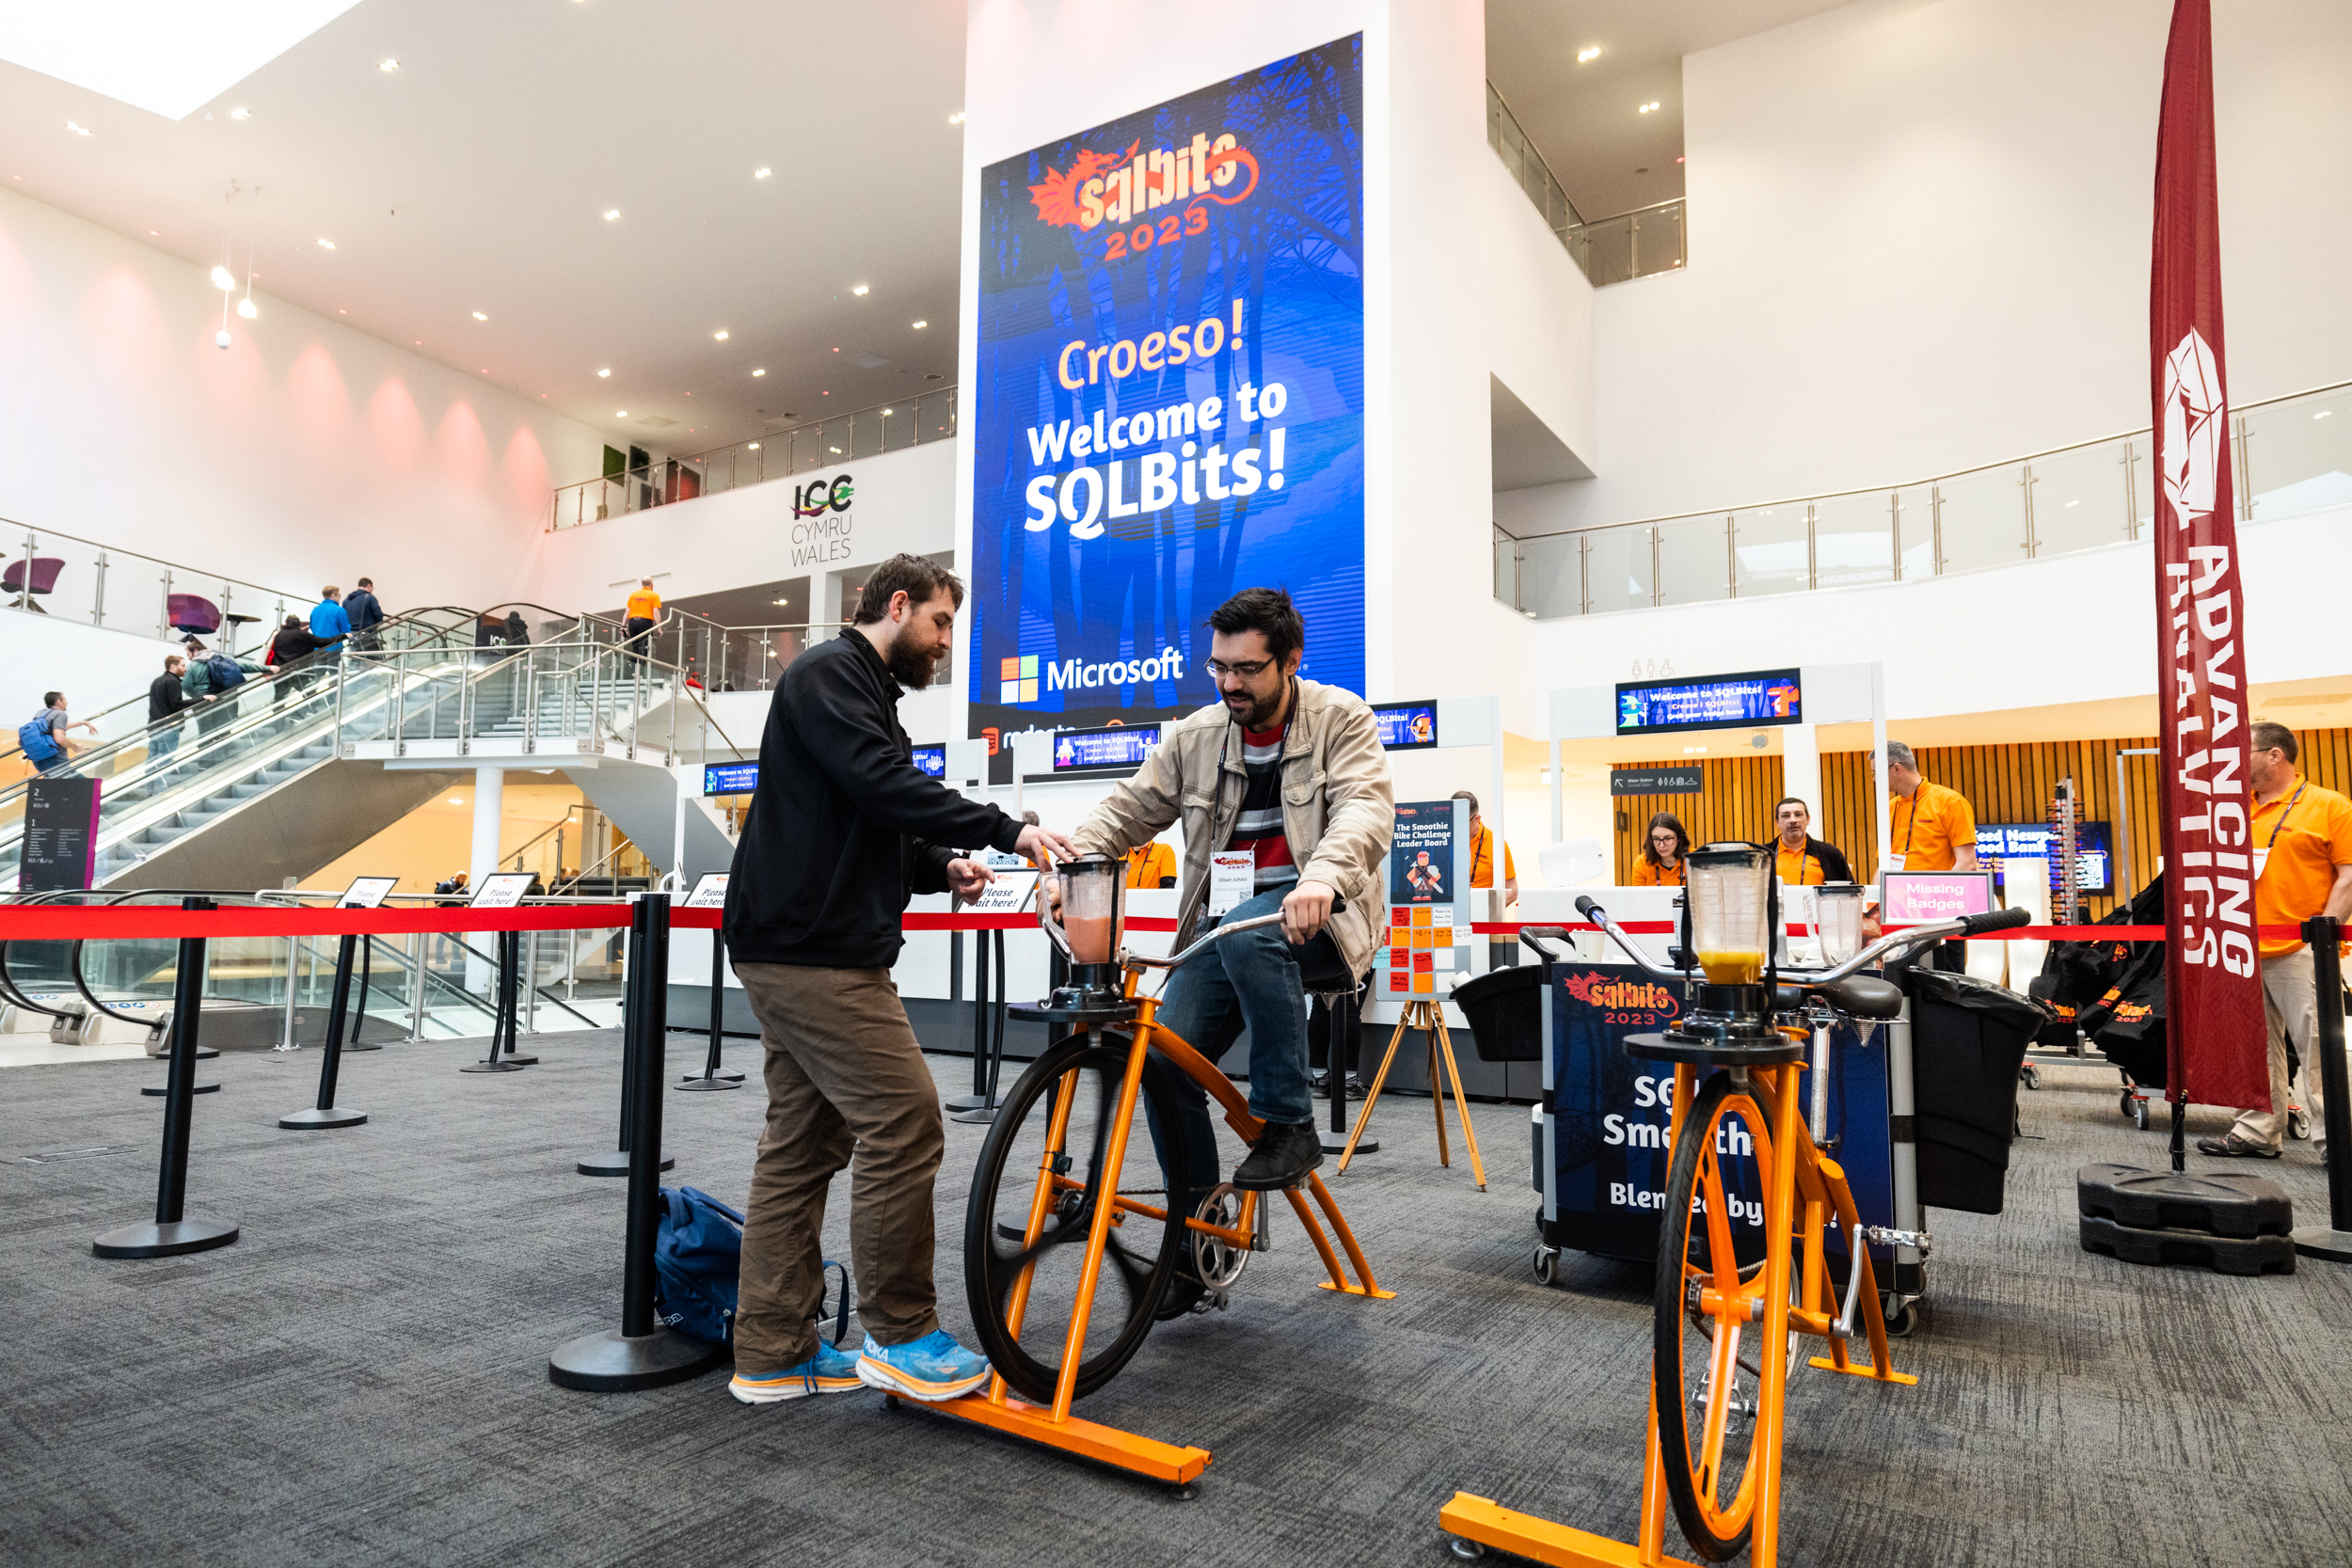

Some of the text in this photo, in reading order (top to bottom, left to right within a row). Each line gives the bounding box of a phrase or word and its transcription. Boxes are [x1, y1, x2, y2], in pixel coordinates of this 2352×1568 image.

[1080, 131, 1238, 231] sqlbits
[1104, 214, 1209, 261] 2023
[1057, 297, 1245, 390] Croeso!
[1027, 382, 1288, 467] Welcome to
[1024, 427, 1287, 541] SQLBits!
[794, 474, 852, 520] ICC
[791, 515, 852, 545] CYMRU
[791, 538, 851, 567] WALES
[1046, 646, 1184, 695] Microsoft
[1650, 686, 1762, 702] Welcome to SQLBits!
[2188, 546, 2255, 979] ADVANCING
[34, 787, 40, 797] 2
[1393, 831, 1452, 840] Bike Challenge
[1396, 821, 1449, 832] The Smoothie
[1974, 829, 2004, 842] eed
[1424, 838, 1448, 847] Board
[2008, 840, 2047, 853] Bank
[982, 888, 1013, 897] Please
[1907, 883, 1964, 896] Missing
[708, 897, 725, 906] here
[991, 898, 1018, 908] here!
[1907, 898, 1965, 911] Badges
[1592, 981, 1669, 1009] sqlbits
[1605, 1012, 1656, 1025] 2023
[1728, 1194, 1763, 1227] by
[864, 1335, 889, 1362] HOKA
